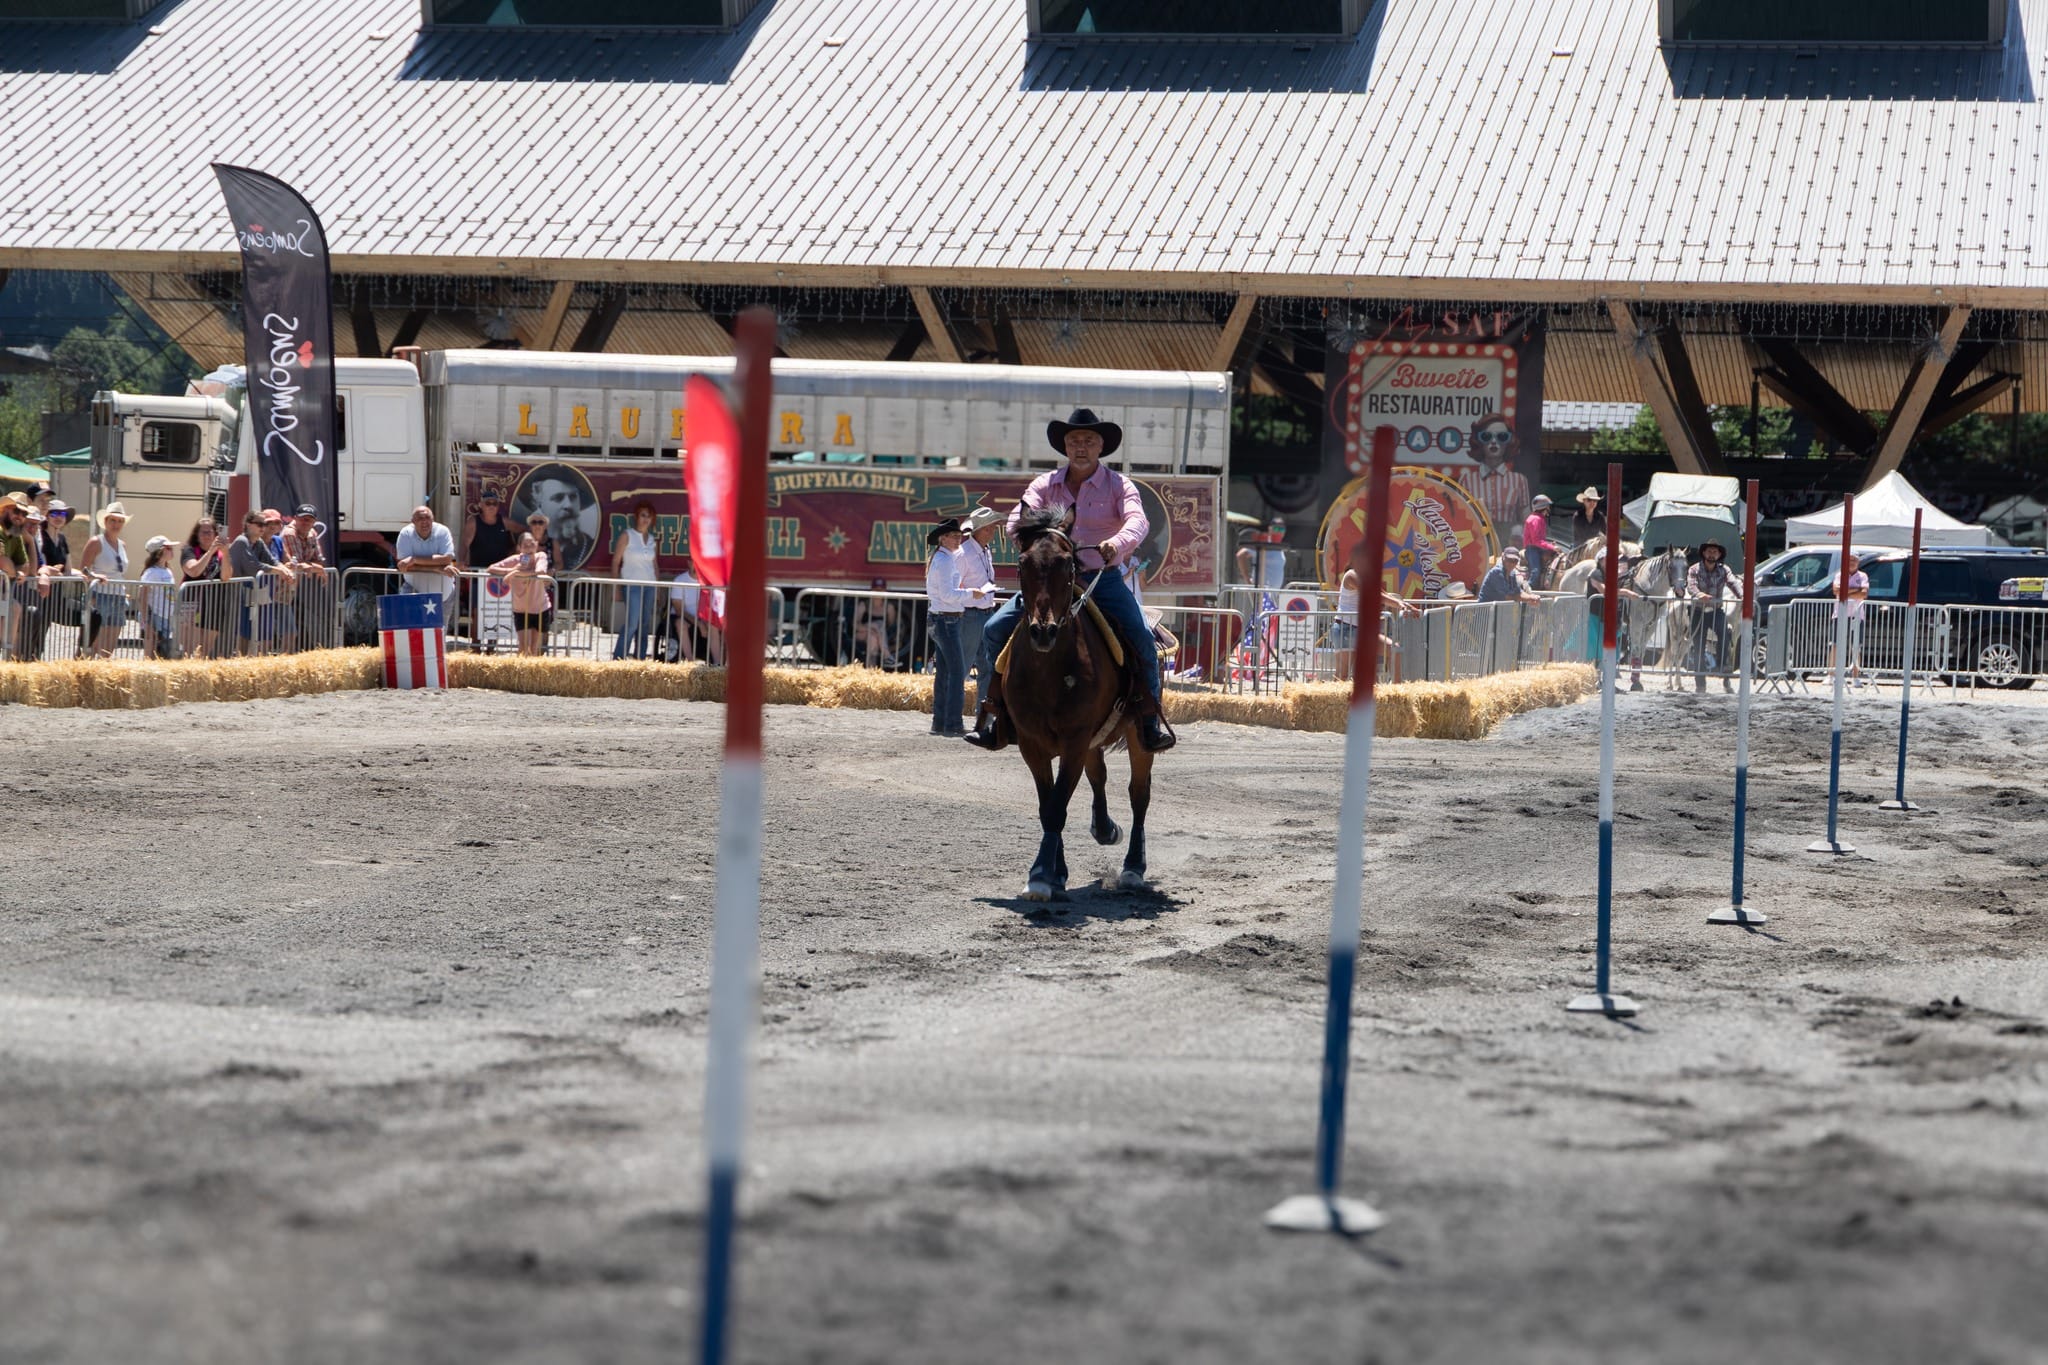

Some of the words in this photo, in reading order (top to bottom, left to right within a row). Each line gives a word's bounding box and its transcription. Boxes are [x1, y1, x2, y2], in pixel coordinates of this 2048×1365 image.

[1390, 363, 1489, 389] Buvette
[1368, 394, 1494, 416] RESTAURATION
[774, 471, 867, 492] BUFFALO
[870, 473, 915, 495] BILL
[1403, 497, 1462, 563] Laurera
